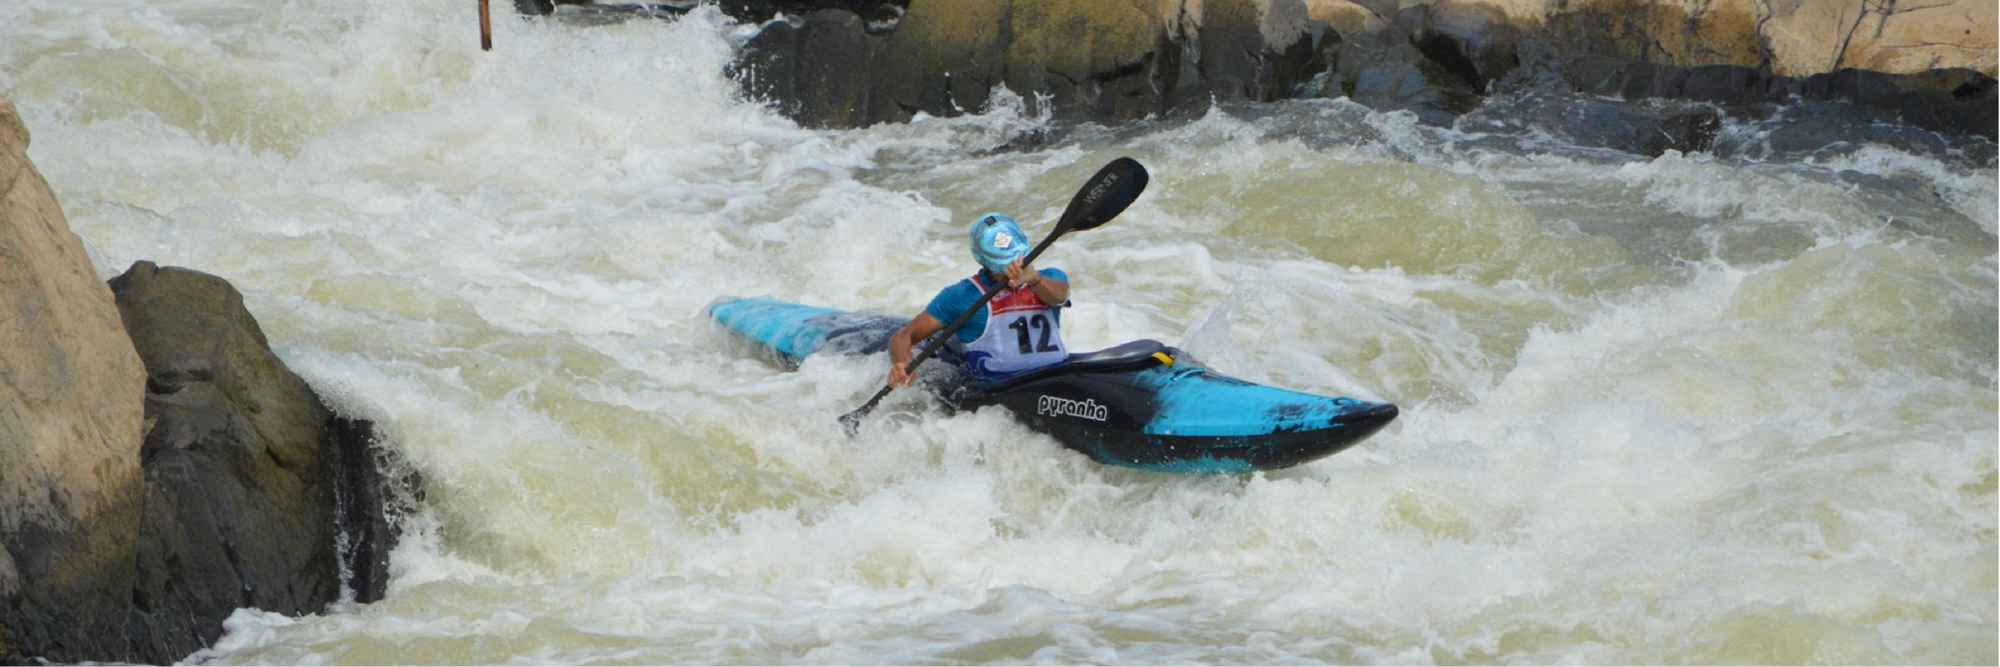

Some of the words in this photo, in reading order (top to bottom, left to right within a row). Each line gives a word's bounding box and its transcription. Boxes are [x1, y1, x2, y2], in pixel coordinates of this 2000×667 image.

[1083, 173, 1119, 204] WERNER
[1009, 314, 1060, 354] 12
[1038, 395, 1107, 421] pyranha
